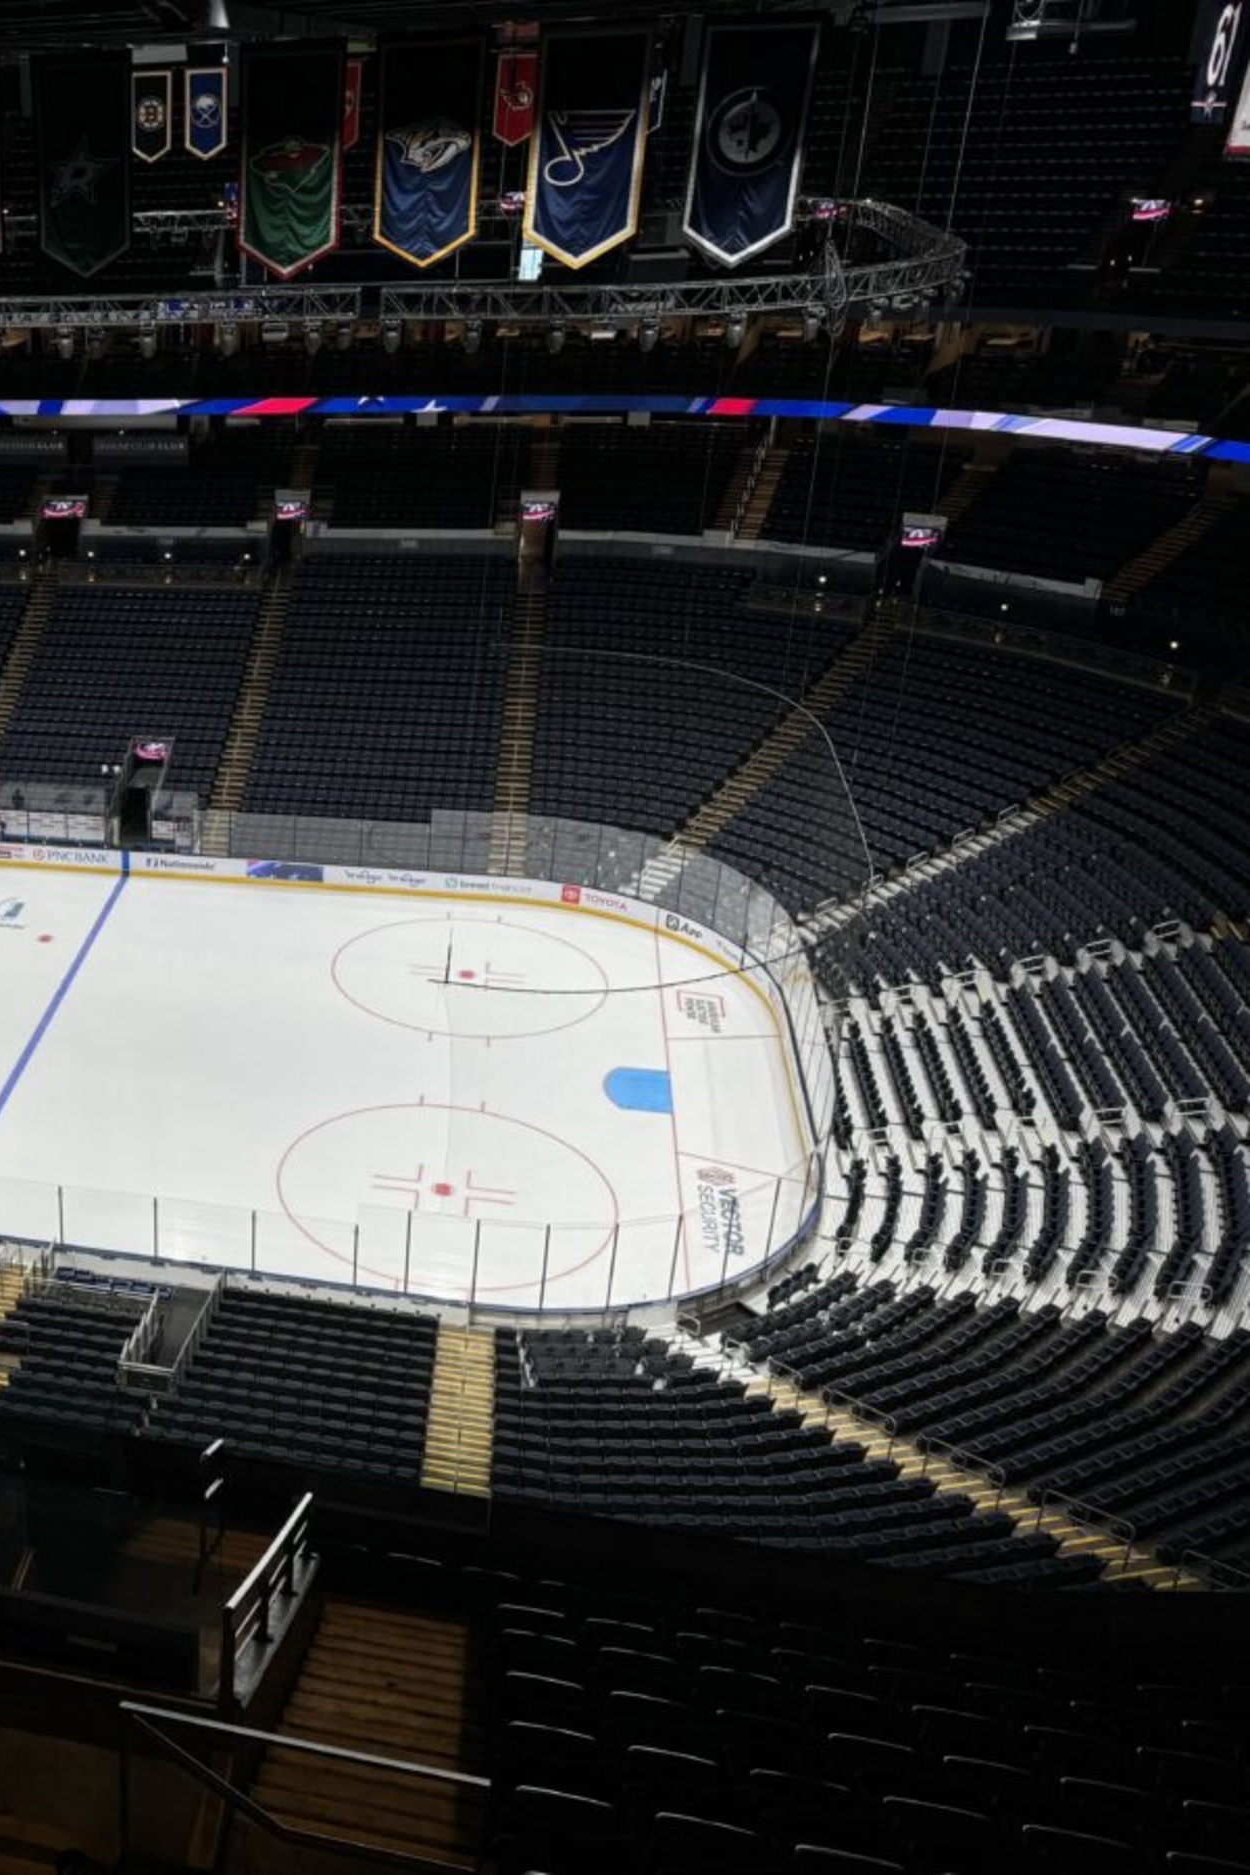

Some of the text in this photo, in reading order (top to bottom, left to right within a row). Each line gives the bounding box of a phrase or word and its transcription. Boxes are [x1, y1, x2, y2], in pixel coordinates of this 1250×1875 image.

[584, 893, 628, 912] TOYOTA
[697, 1184, 720, 1253] SECURITY
[718, 1187, 745, 1257] VECTOR
